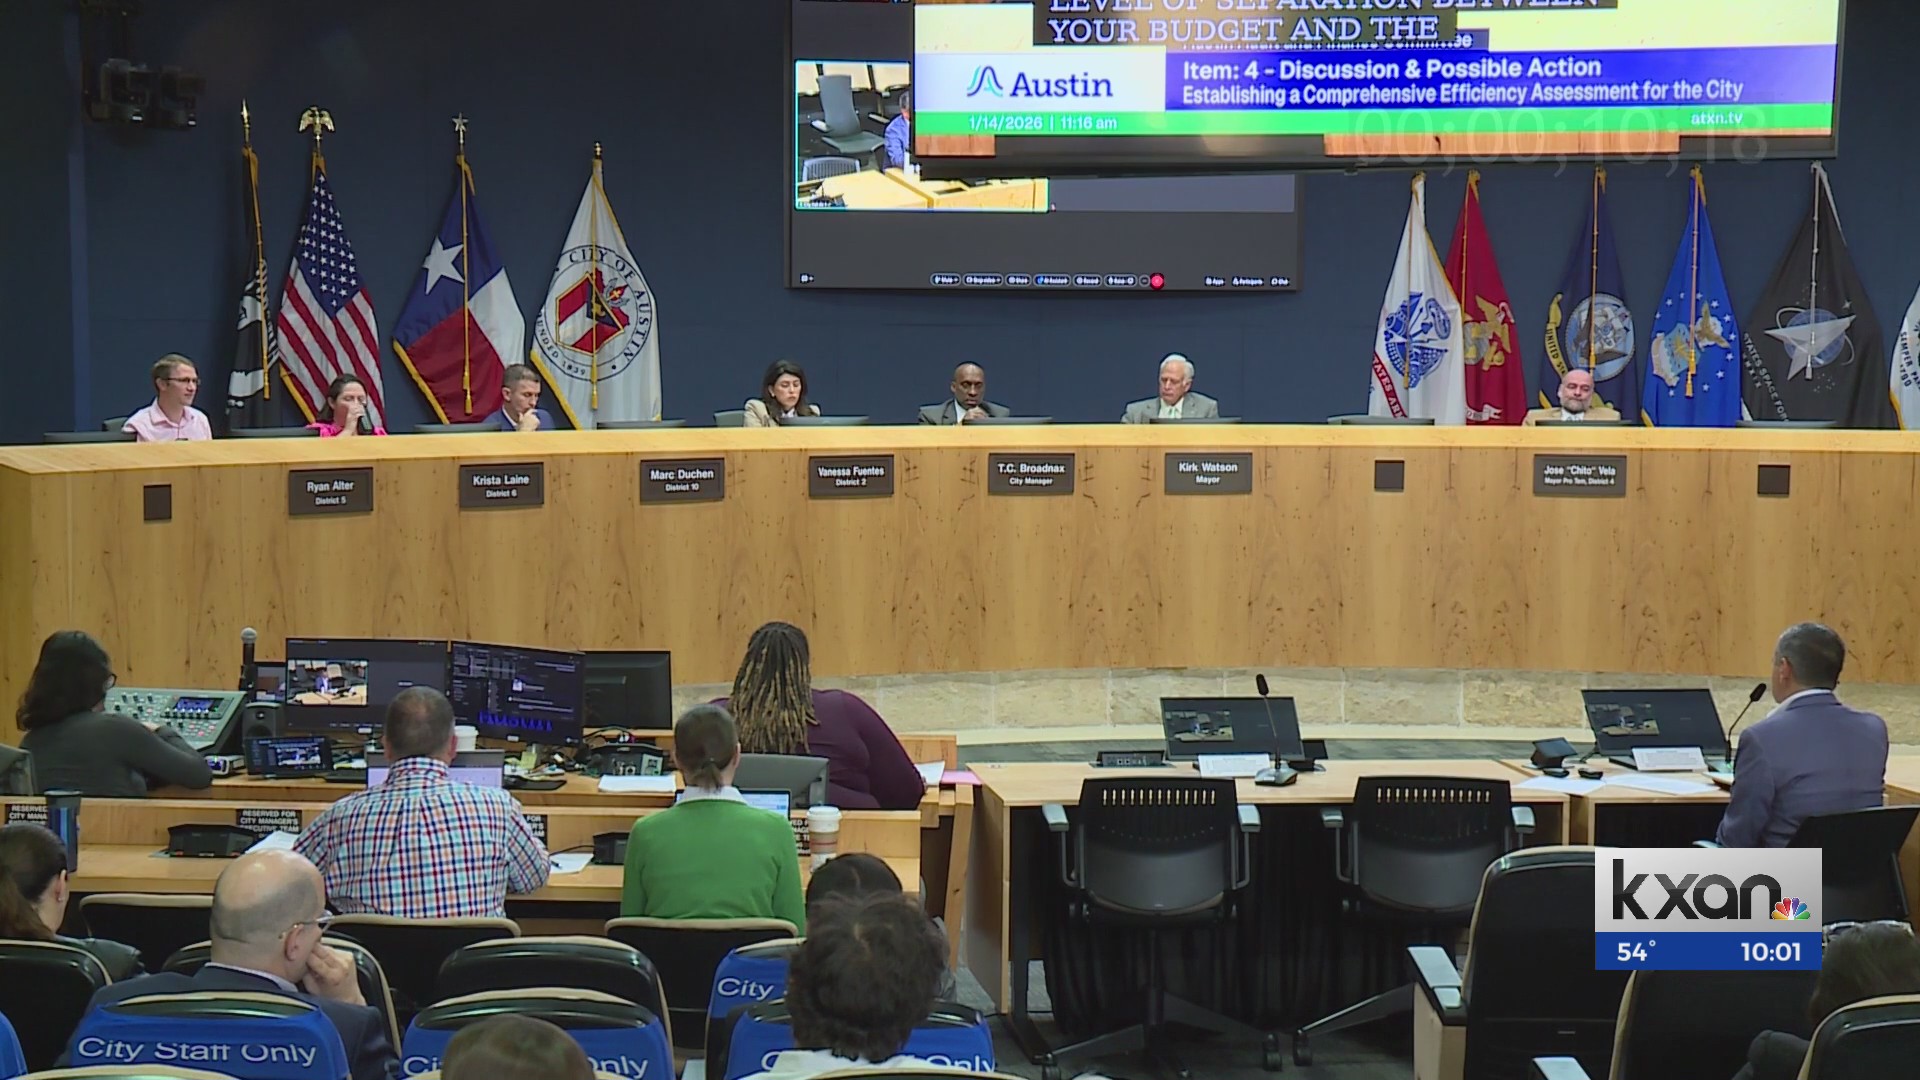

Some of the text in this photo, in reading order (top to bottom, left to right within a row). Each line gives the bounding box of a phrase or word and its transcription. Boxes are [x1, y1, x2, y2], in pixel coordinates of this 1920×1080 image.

[1048, 15, 1439, 43] YOUR BUDGET AND THE
[1183, 60, 1240, 80] Item:
[1244, 61, 1259, 80] 4
[1279, 58, 1400, 81] Discussion
[1404, 59, 1421, 80] &
[1426, 57, 1523, 80] Possible
[1527, 56, 1602, 78] Action
[1009, 71, 1114, 98] Austin
[1183, 79, 1744, 108] Establishing a Comprehensive Efficiency Assessment for the City
[969, 115, 1043, 131] 1/14/2026
[1060, 115, 1093, 131] 11:16
[1096, 118, 1118, 130] am
[1691, 112, 1744, 126] atxn.tv
[569, 247, 650, 362] CITY OF AUSTIN
[1373, 355, 1393, 392] TATES
[1759, 367, 1779, 401] SPACE
[818, 466, 885, 477] Vanessa Fuentes
[998, 463, 1065, 473] T.C. Broadnax
[1179, 462, 1238, 472] Kirk Watson
[1544, 464, 1564, 475] Jose
[1598, 465, 1616, 475] Vela
[650, 468, 714, 480] Marc Duchen
[473, 474, 530, 486] Krista Laine
[835, 478, 860, 486] District
[1009, 476, 1053, 486] City Manager
[1195, 475, 1220, 485] Mayor
[1588, 477, 1609, 485] District
[306, 480, 355, 493] Ryan Alter
[665, 482, 700, 492] District 10
[486, 489, 518, 498] District 6
[315, 495, 347, 505] District 5
[9, 812, 26, 820] CITY
[242, 810, 296, 818] RESERVED FOR
[240, 817, 257, 825] CITY
[717, 977, 775, 1000] City
[78, 1036, 144, 1063] City
[241, 1043, 317, 1068] Only
